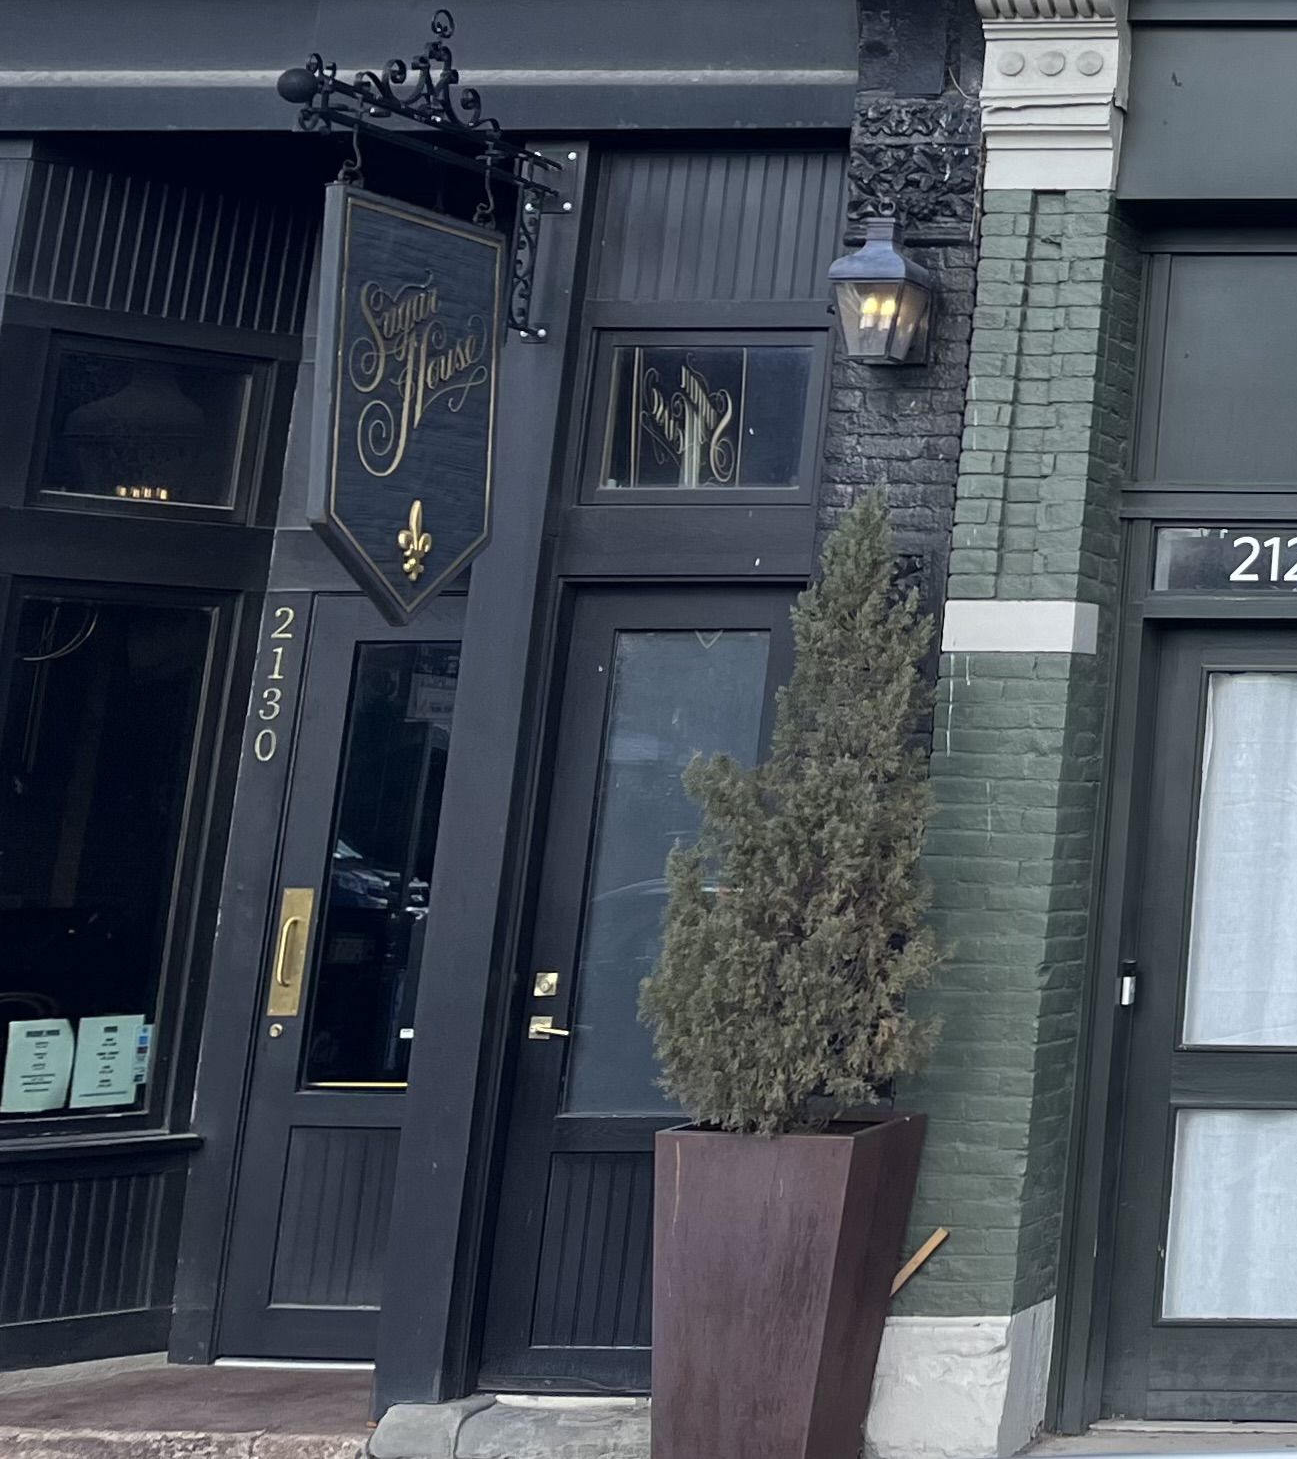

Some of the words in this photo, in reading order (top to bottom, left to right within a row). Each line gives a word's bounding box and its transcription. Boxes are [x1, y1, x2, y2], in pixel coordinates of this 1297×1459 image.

[349, 268, 442, 393] Sugar
[357, 314, 488, 477] House
[253, 606, 296, 762] 2130
